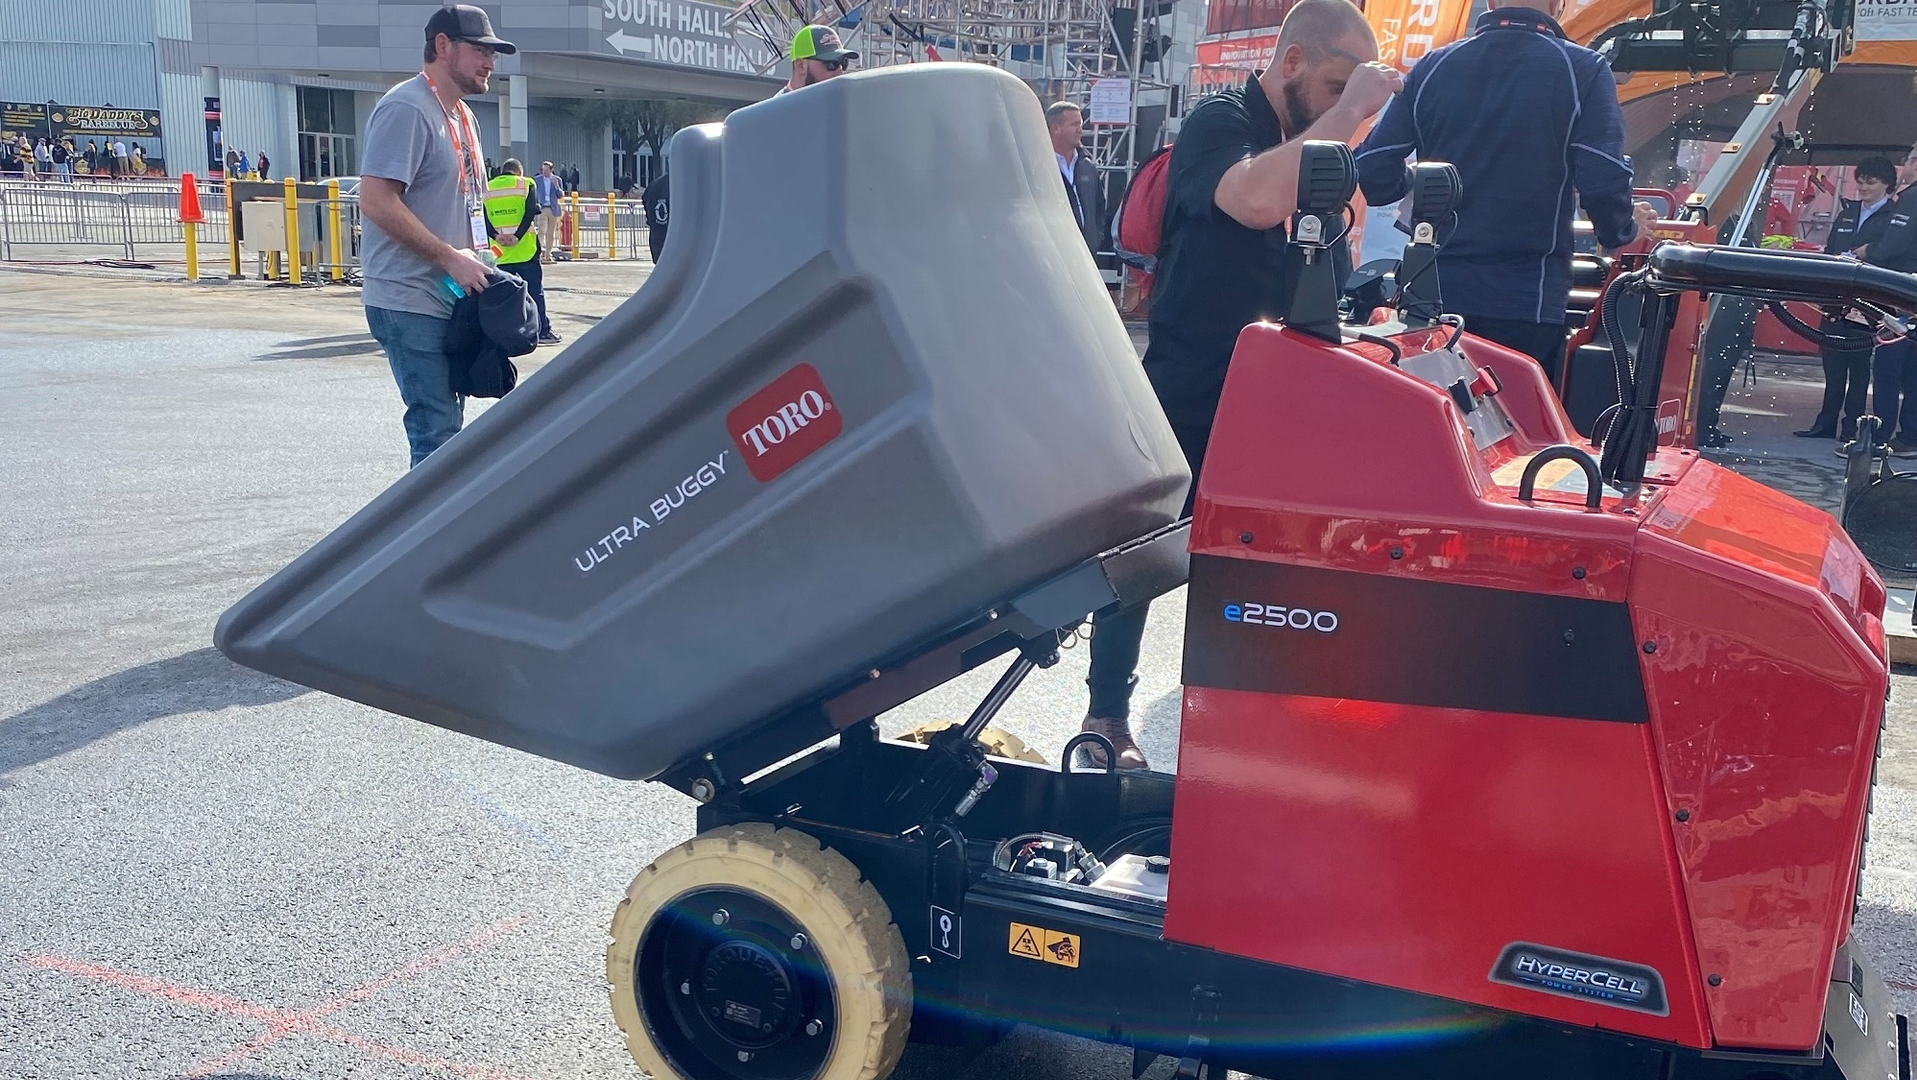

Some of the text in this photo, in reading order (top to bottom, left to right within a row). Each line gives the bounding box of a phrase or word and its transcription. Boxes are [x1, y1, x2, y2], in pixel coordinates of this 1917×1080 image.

[604, 0, 671, 28] SOUTH
[1878, 8, 1903, 16] FAST
[654, 34, 718, 68] NORTH
[1380, 18, 1401, 66] FAS
[80, 119, 136, 130] BARBECUE
[741, 390, 824, 457] TORO
[575, 516, 651, 572] ULTRA
[1224, 602, 1338, 632] e2500
[1541, 979, 1615, 999] POWER SYSTEM
